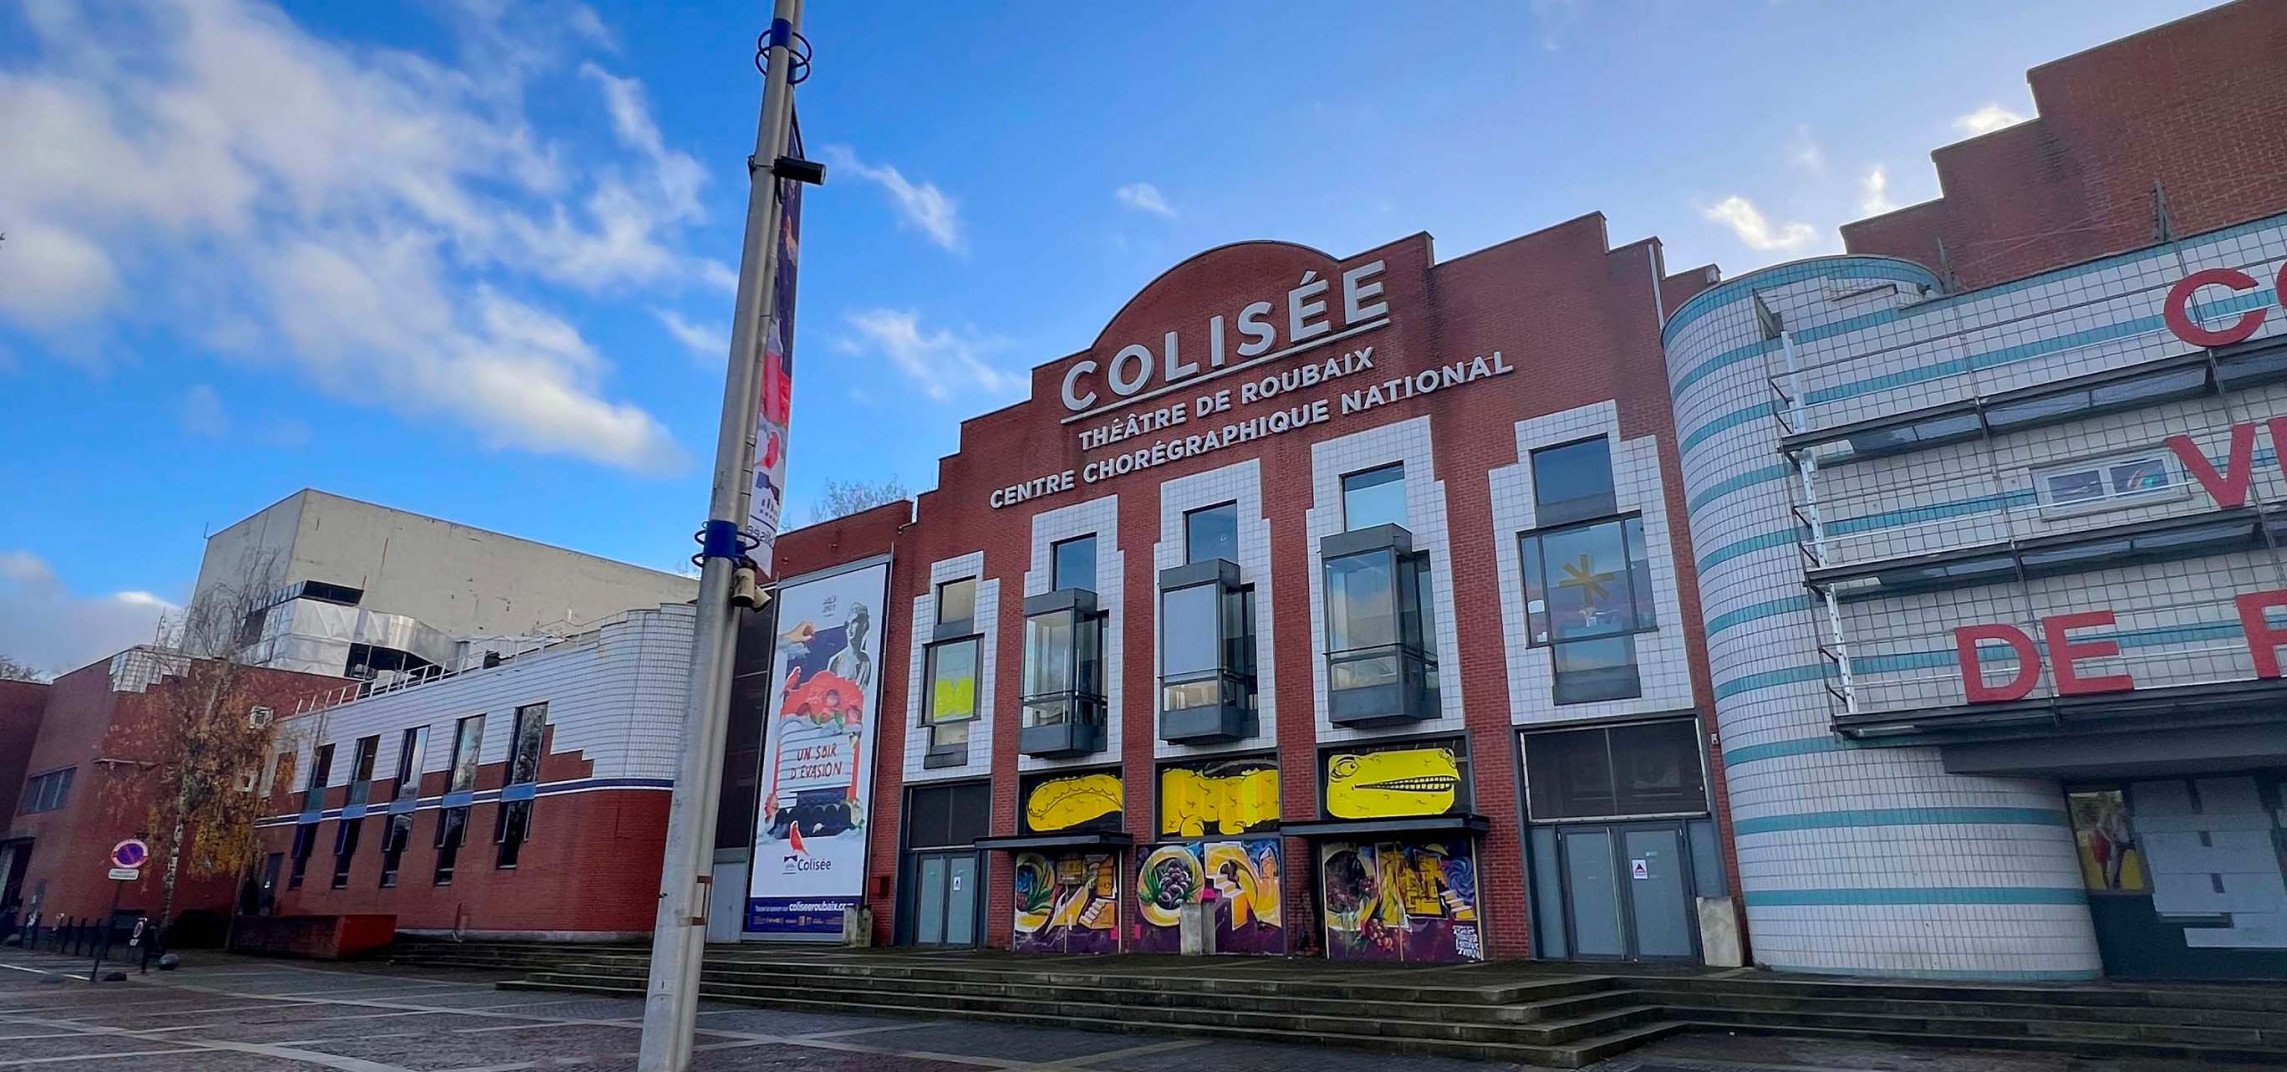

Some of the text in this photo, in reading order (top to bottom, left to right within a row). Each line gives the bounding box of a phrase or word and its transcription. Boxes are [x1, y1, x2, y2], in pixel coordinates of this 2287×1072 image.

[1061, 259, 1389, 412] COLISÉE
[2164, 268, 2287, 347] C
[990, 351, 1514, 509] CENTRE CHORÉGRAPHIQUE NATIONAL
[1079, 345, 1375, 450] THÉÂTRE DE ROUBAIX
[1955, 611, 2135, 705] DE
[797, 742, 837, 761] UN SOIR
[797, 858, 831, 871] Colisée
